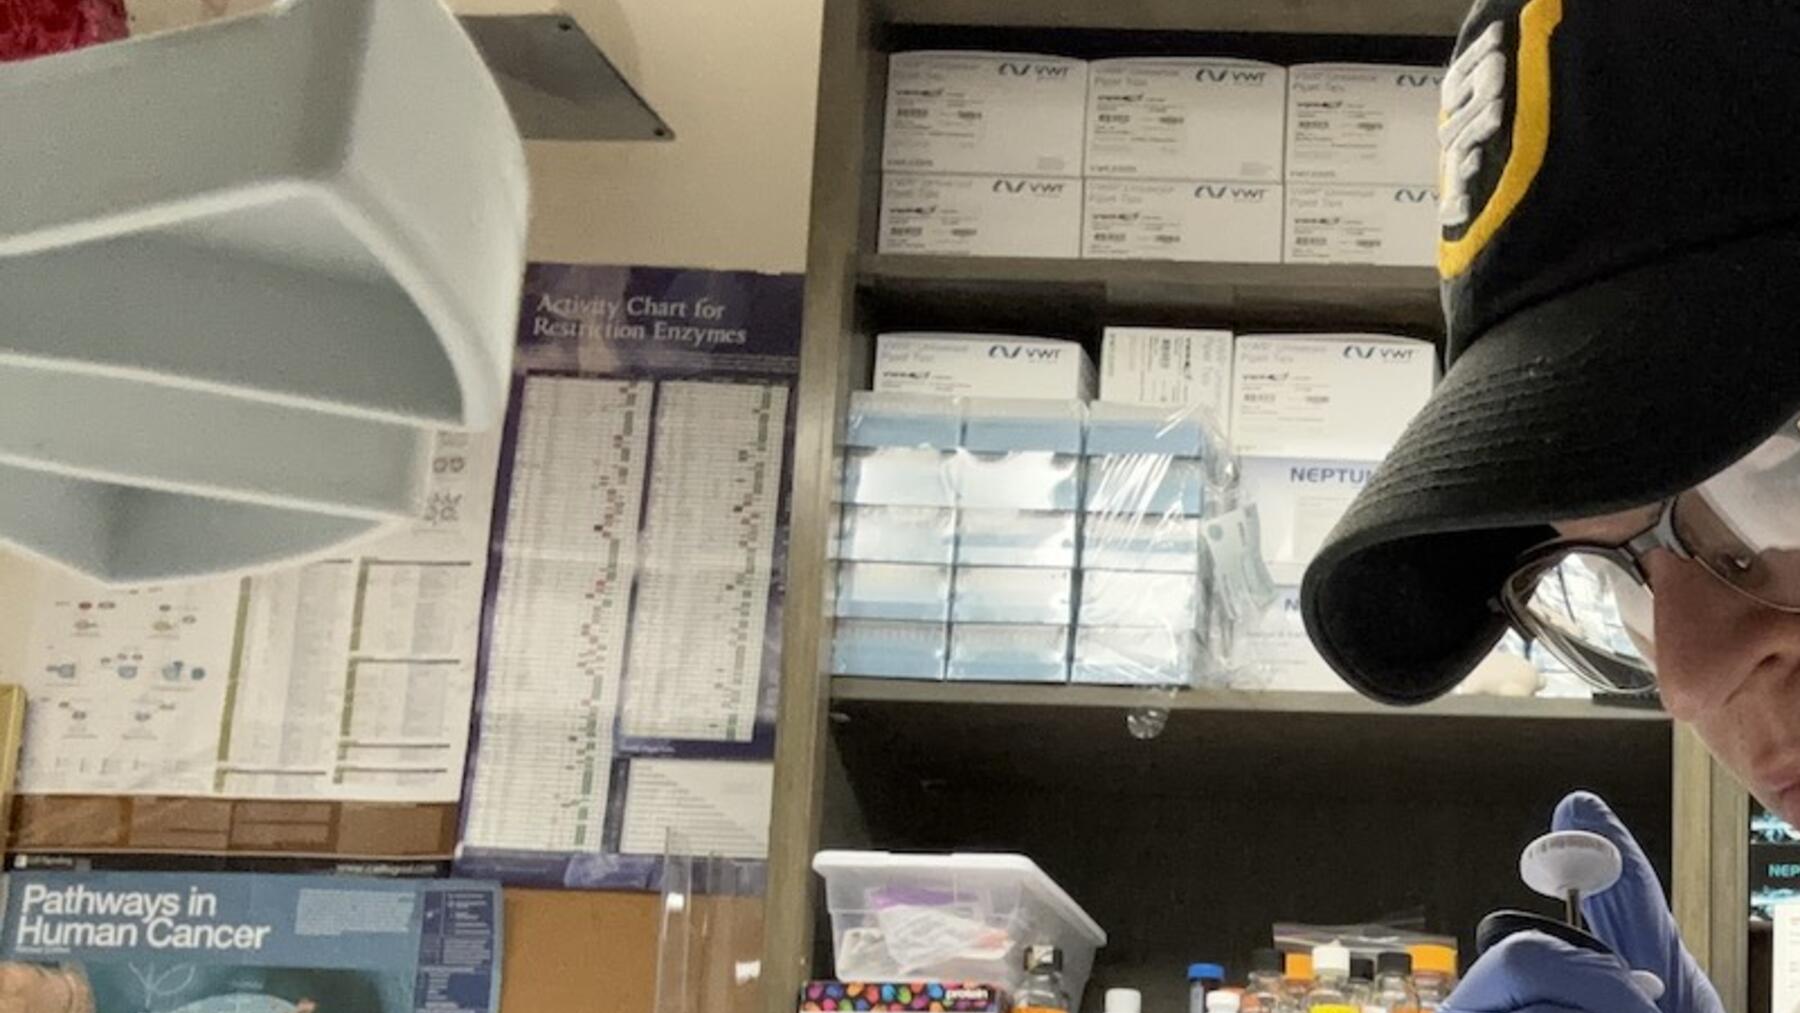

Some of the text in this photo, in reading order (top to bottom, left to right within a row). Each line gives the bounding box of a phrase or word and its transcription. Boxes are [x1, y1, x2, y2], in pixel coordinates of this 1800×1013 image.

[537, 294, 727, 320] Activity Chart for
[533, 316, 748, 347] Restriction Enzymes
[21, 884, 217, 923] Pathways in
[16, 915, 271, 950] Human Cancer
